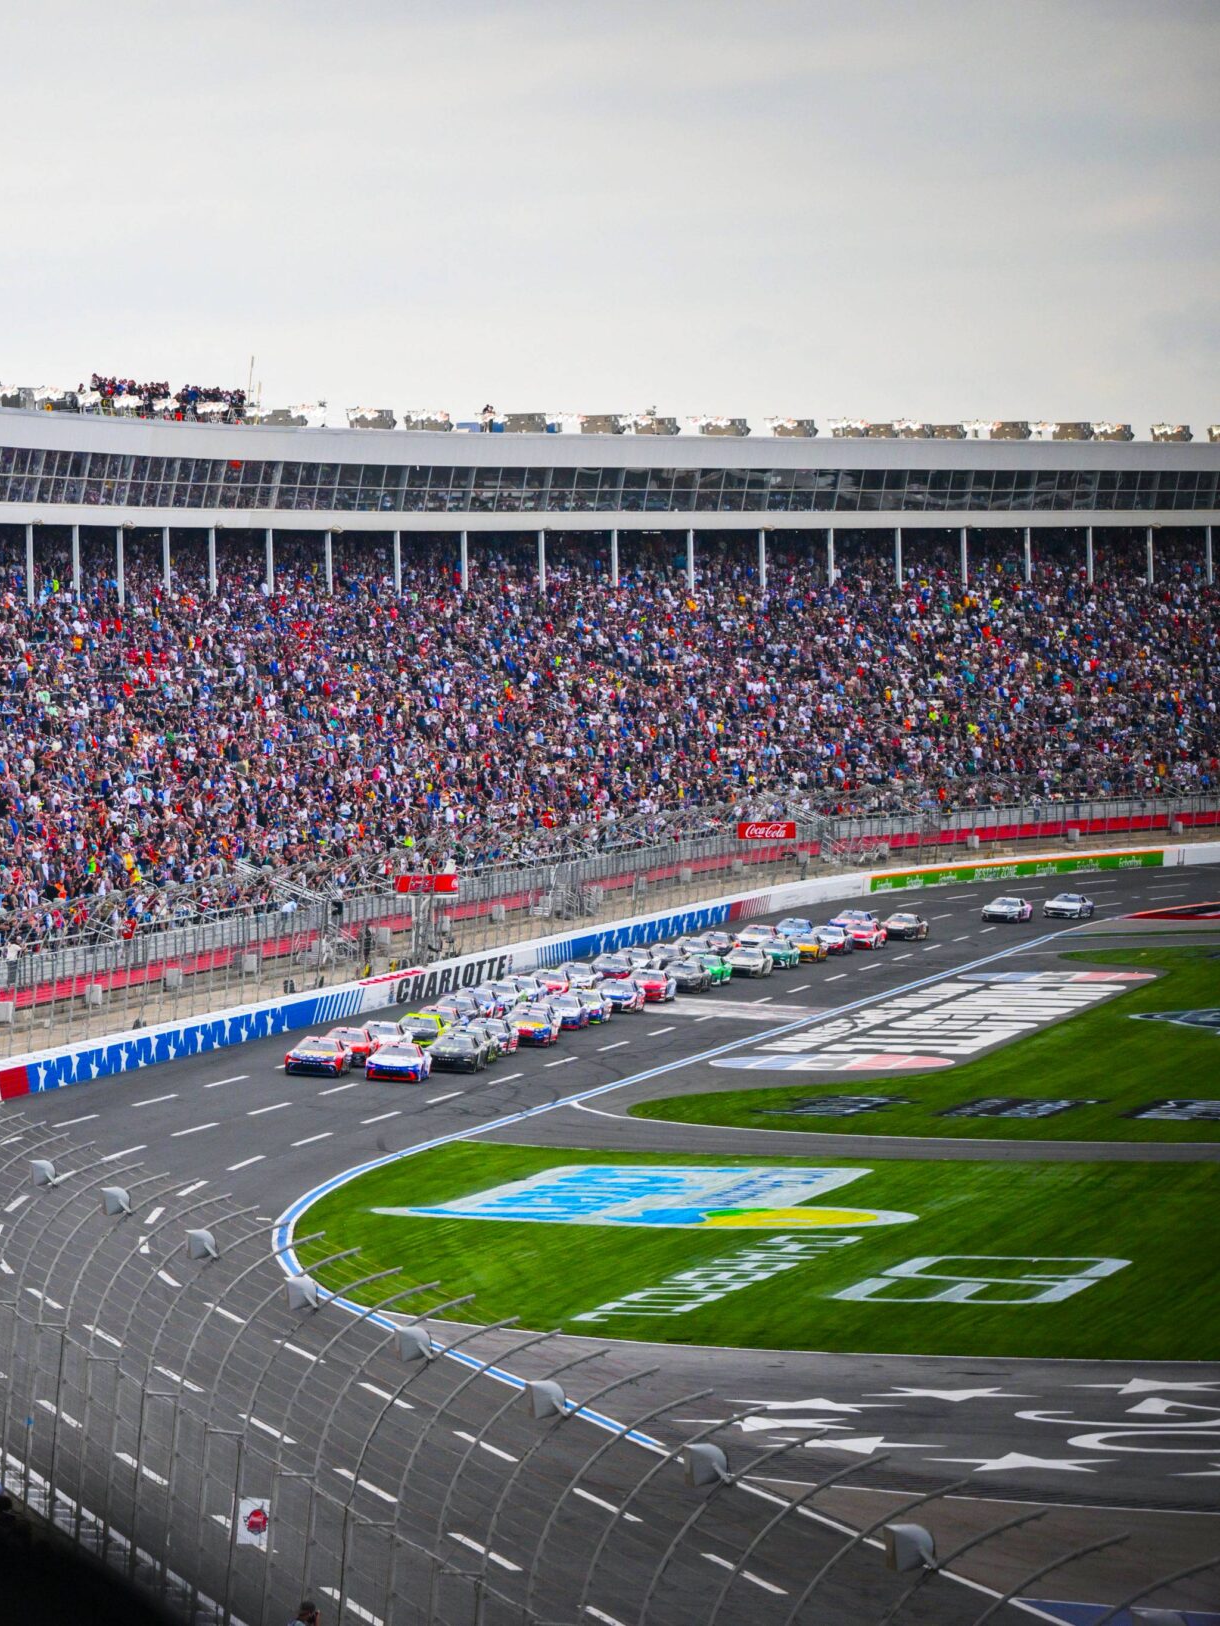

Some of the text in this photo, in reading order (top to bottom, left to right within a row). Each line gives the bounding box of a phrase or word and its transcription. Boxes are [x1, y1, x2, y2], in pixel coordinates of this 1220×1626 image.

[745, 823, 787, 838] Coca-Cola
[974, 865, 1018, 881] RESTART ZONE
[396, 955, 508, 1004] CHARLOTTE
[819, 983, 1127, 1055] CHARLOTTE
